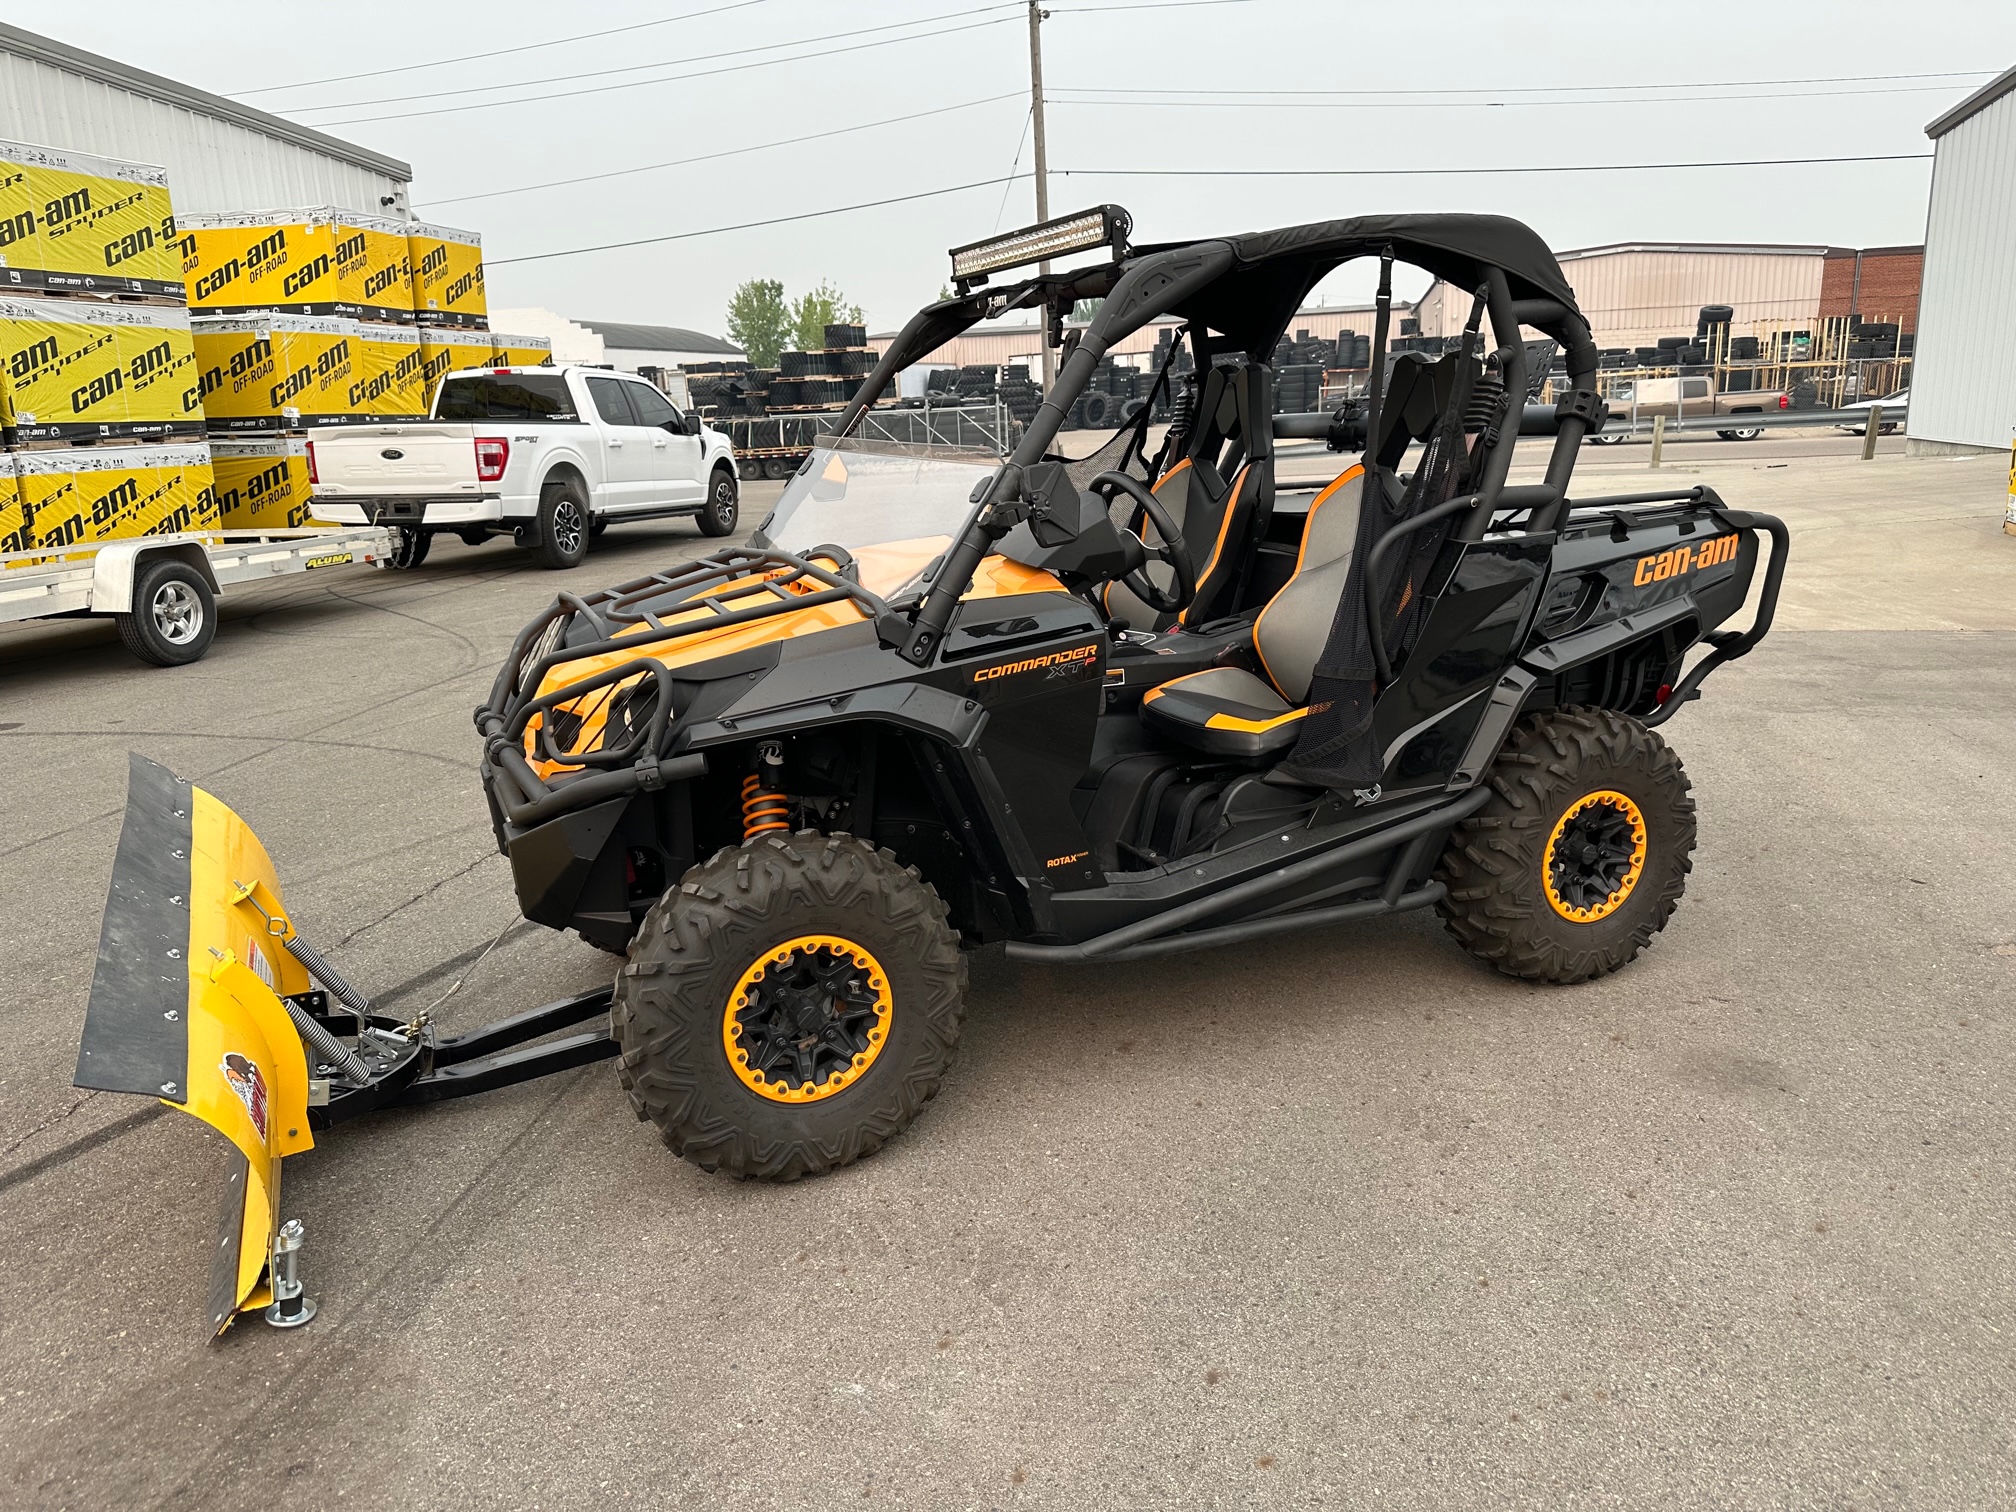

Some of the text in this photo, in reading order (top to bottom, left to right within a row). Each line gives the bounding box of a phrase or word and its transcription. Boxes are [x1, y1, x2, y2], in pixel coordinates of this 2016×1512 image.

[0, 188, 91, 248] an-am
[49, 192, 143, 240] SPYDER
[104, 215, 177, 268] can-a
[48, 277, 81, 285] can-am
[195, 229, 285, 301] can-am
[249, 251, 288, 284] OFF-ROAD
[283, 232, 366, 298] can-am
[364, 255, 410, 299] can-a
[445, 263, 484, 306] can-a
[15, 334, 113, 392] SPYDER
[72, 341, 171, 414] can-am
[134, 351, 196, 393] SPYD
[233, 359, 275, 394] OFF-ROAD
[270, 339, 349, 409] can-am
[320, 361, 351, 391] OFF-ROAD
[17, 428, 46, 436] an-am
[96, 475, 181, 539] SPYDER
[250, 483, 292, 515] OFF-ROAD
[306, 552, 353, 568] ALUMA
[1633, 533, 1739, 587] can-am
[973, 644, 1098, 682] COMMANDER
[1046, 853, 1077, 868] ROTAX
